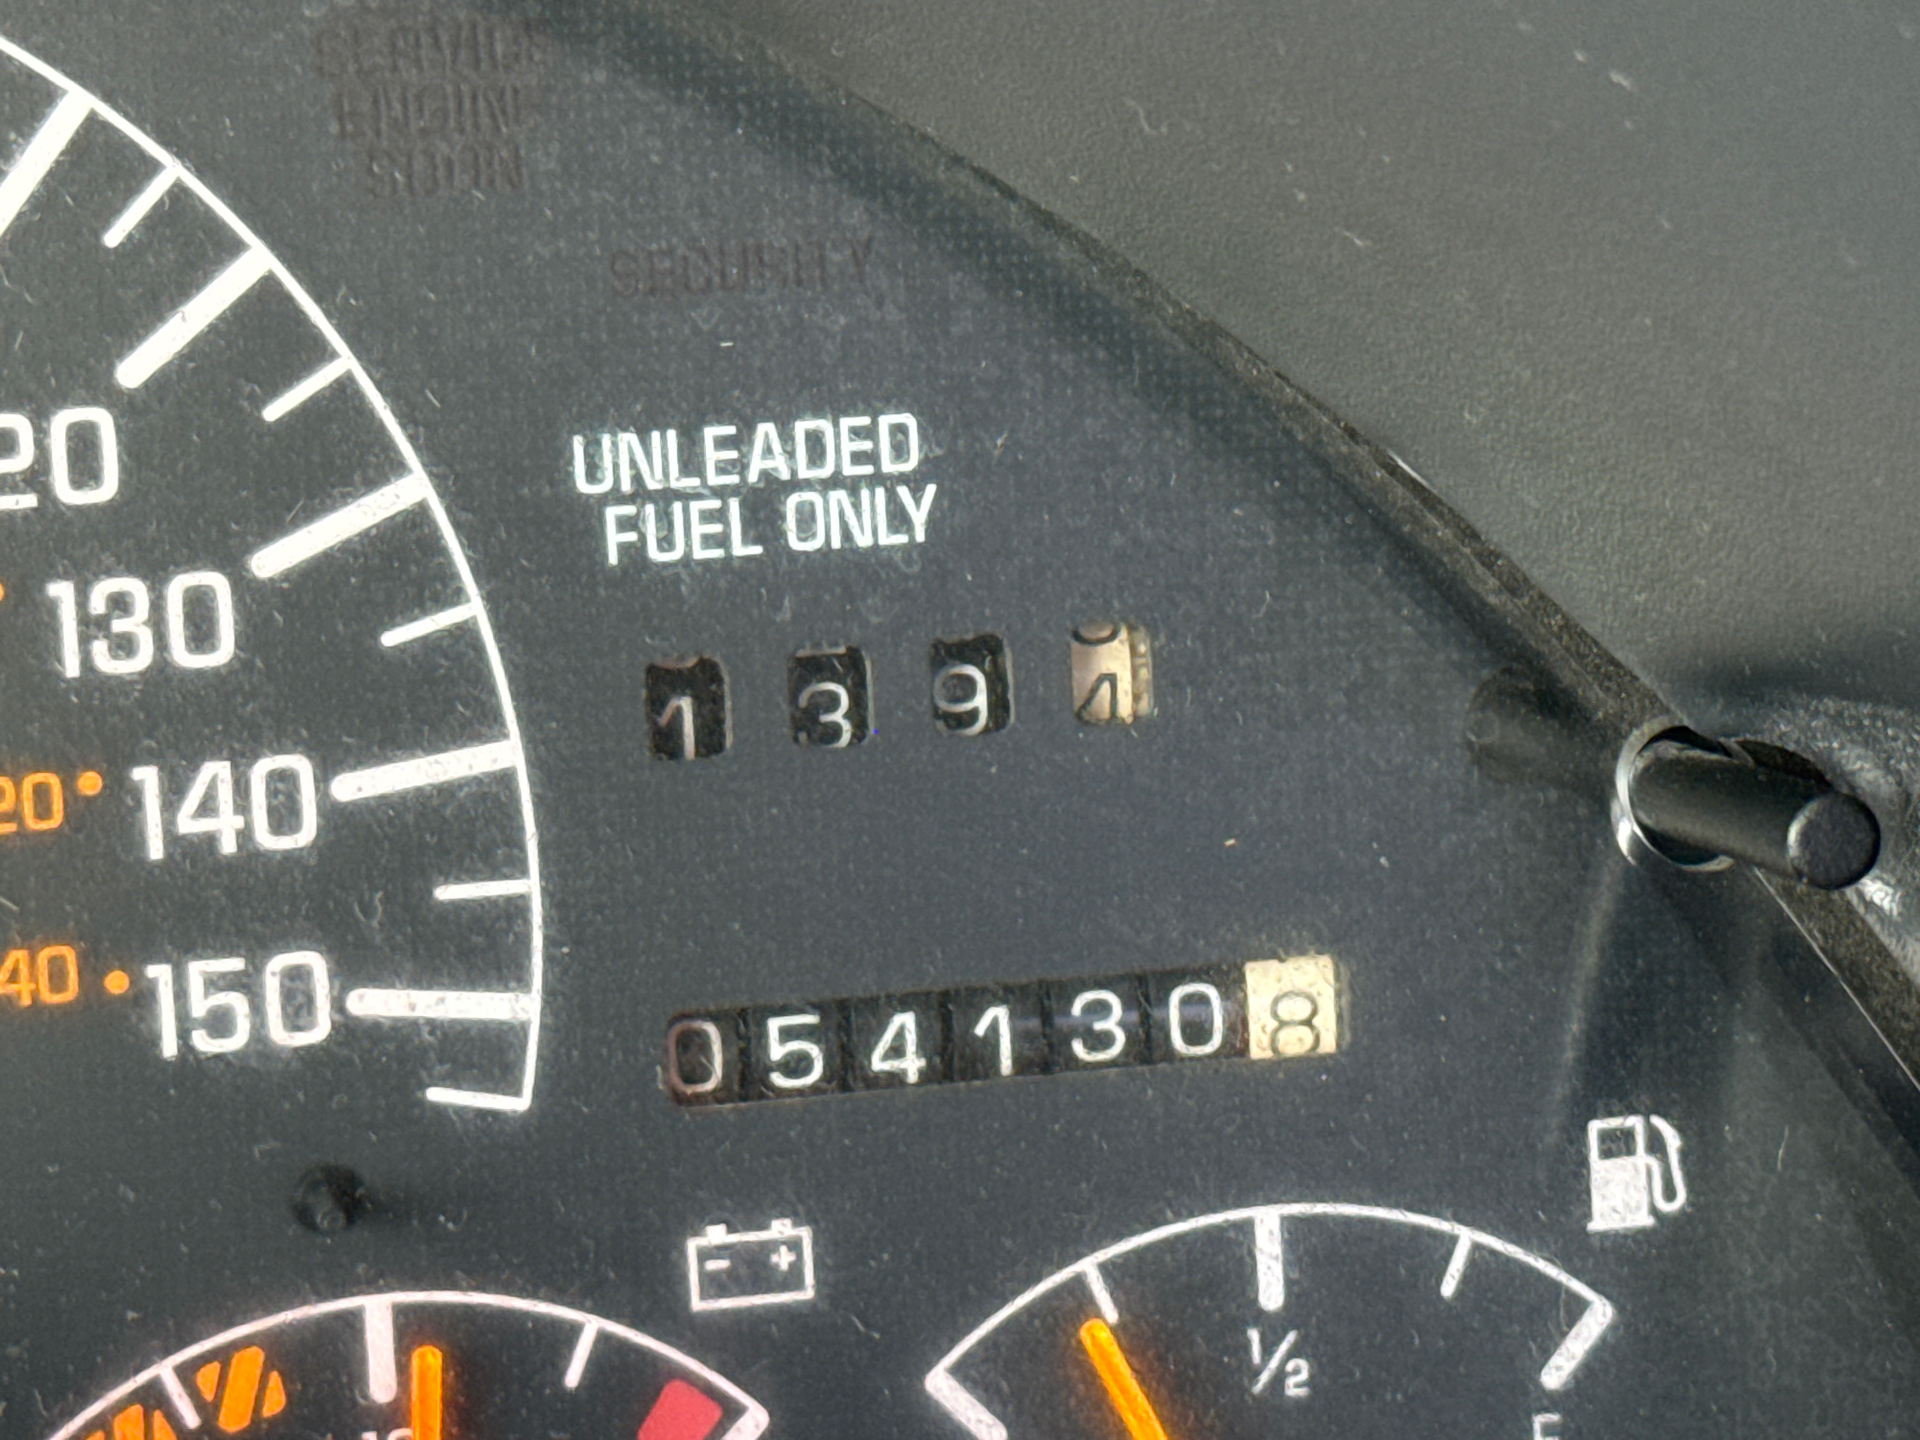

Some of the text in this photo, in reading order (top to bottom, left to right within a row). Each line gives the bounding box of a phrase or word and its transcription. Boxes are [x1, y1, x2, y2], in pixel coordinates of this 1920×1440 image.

[609, 234, 876, 300] SECURITY
[573, 413, 920, 495] UNLEADED
[604, 484, 937, 566] FUEL ONLY
[46, 571, 235, 678] 130
[131, 754, 317, 860] 140
[145, 951, 332, 1059] 150
